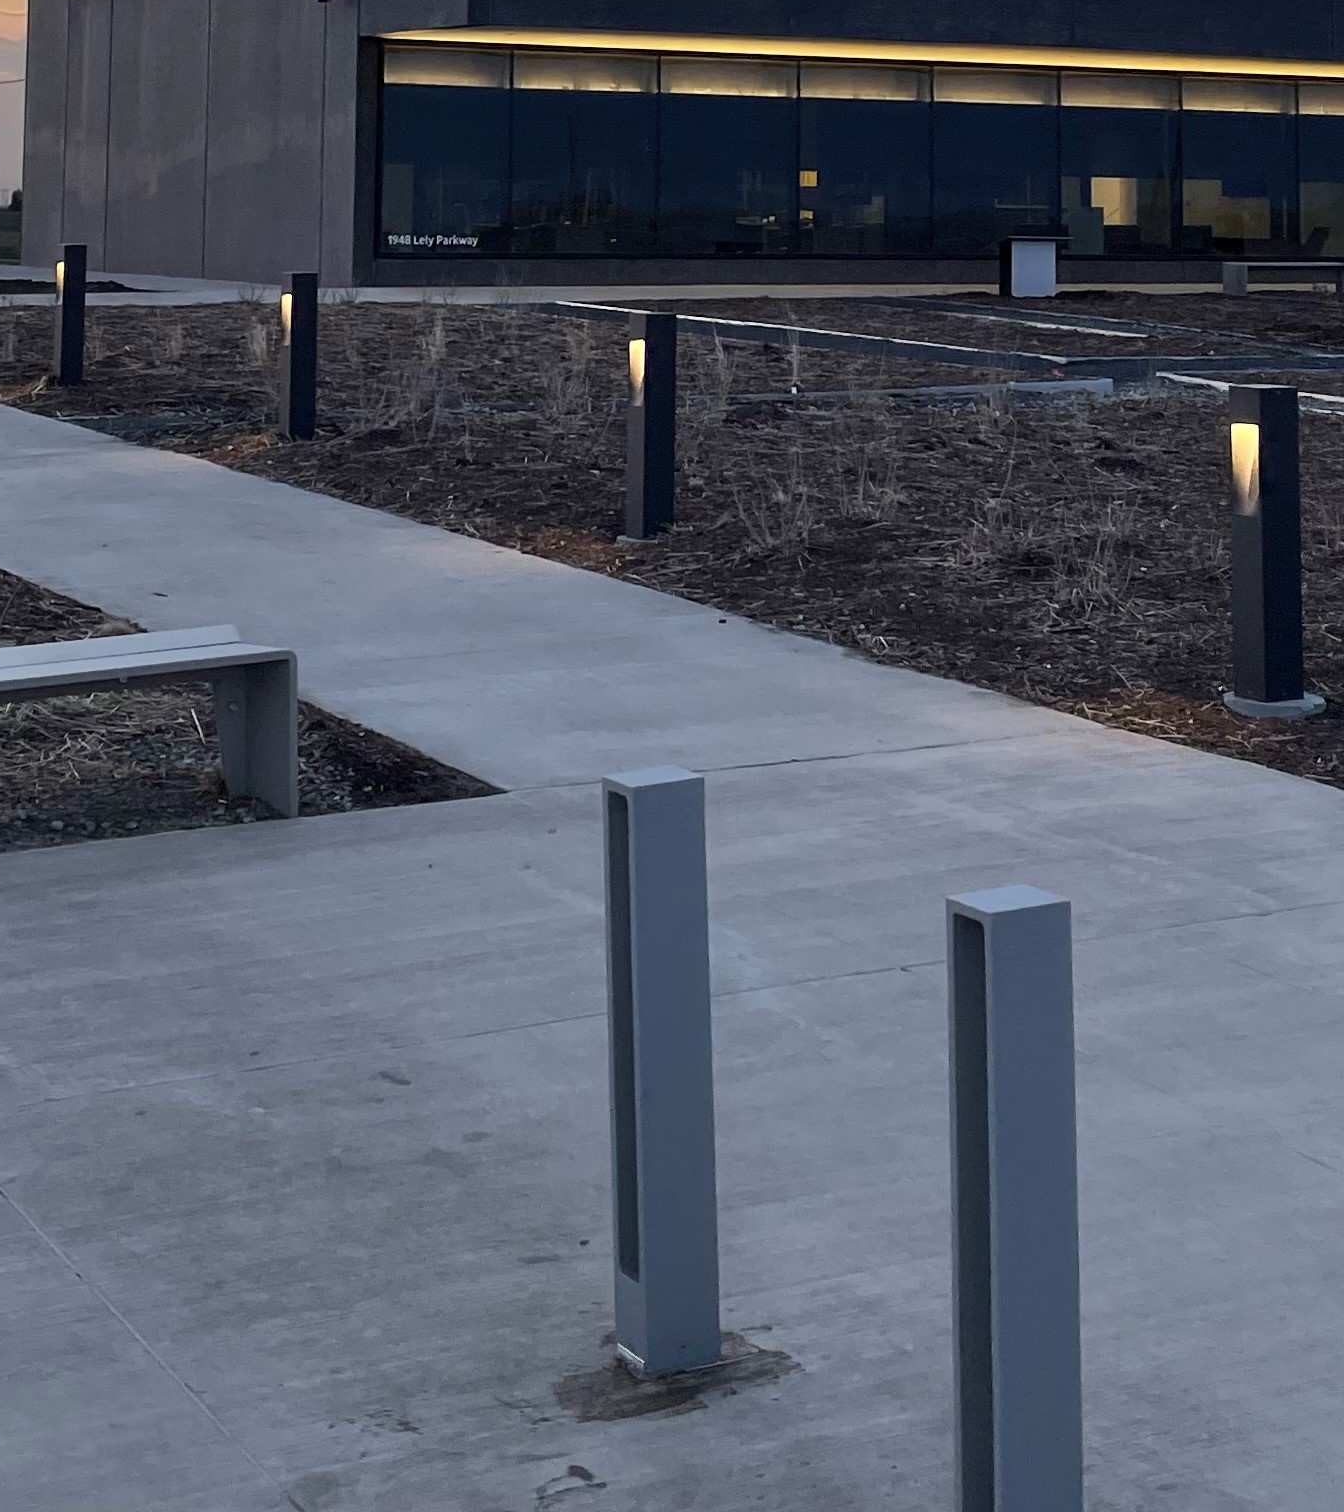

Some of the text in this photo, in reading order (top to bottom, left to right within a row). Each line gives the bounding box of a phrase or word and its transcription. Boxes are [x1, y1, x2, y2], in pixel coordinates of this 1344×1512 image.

[387, 234, 479, 248] 1948 Lely Parkway
